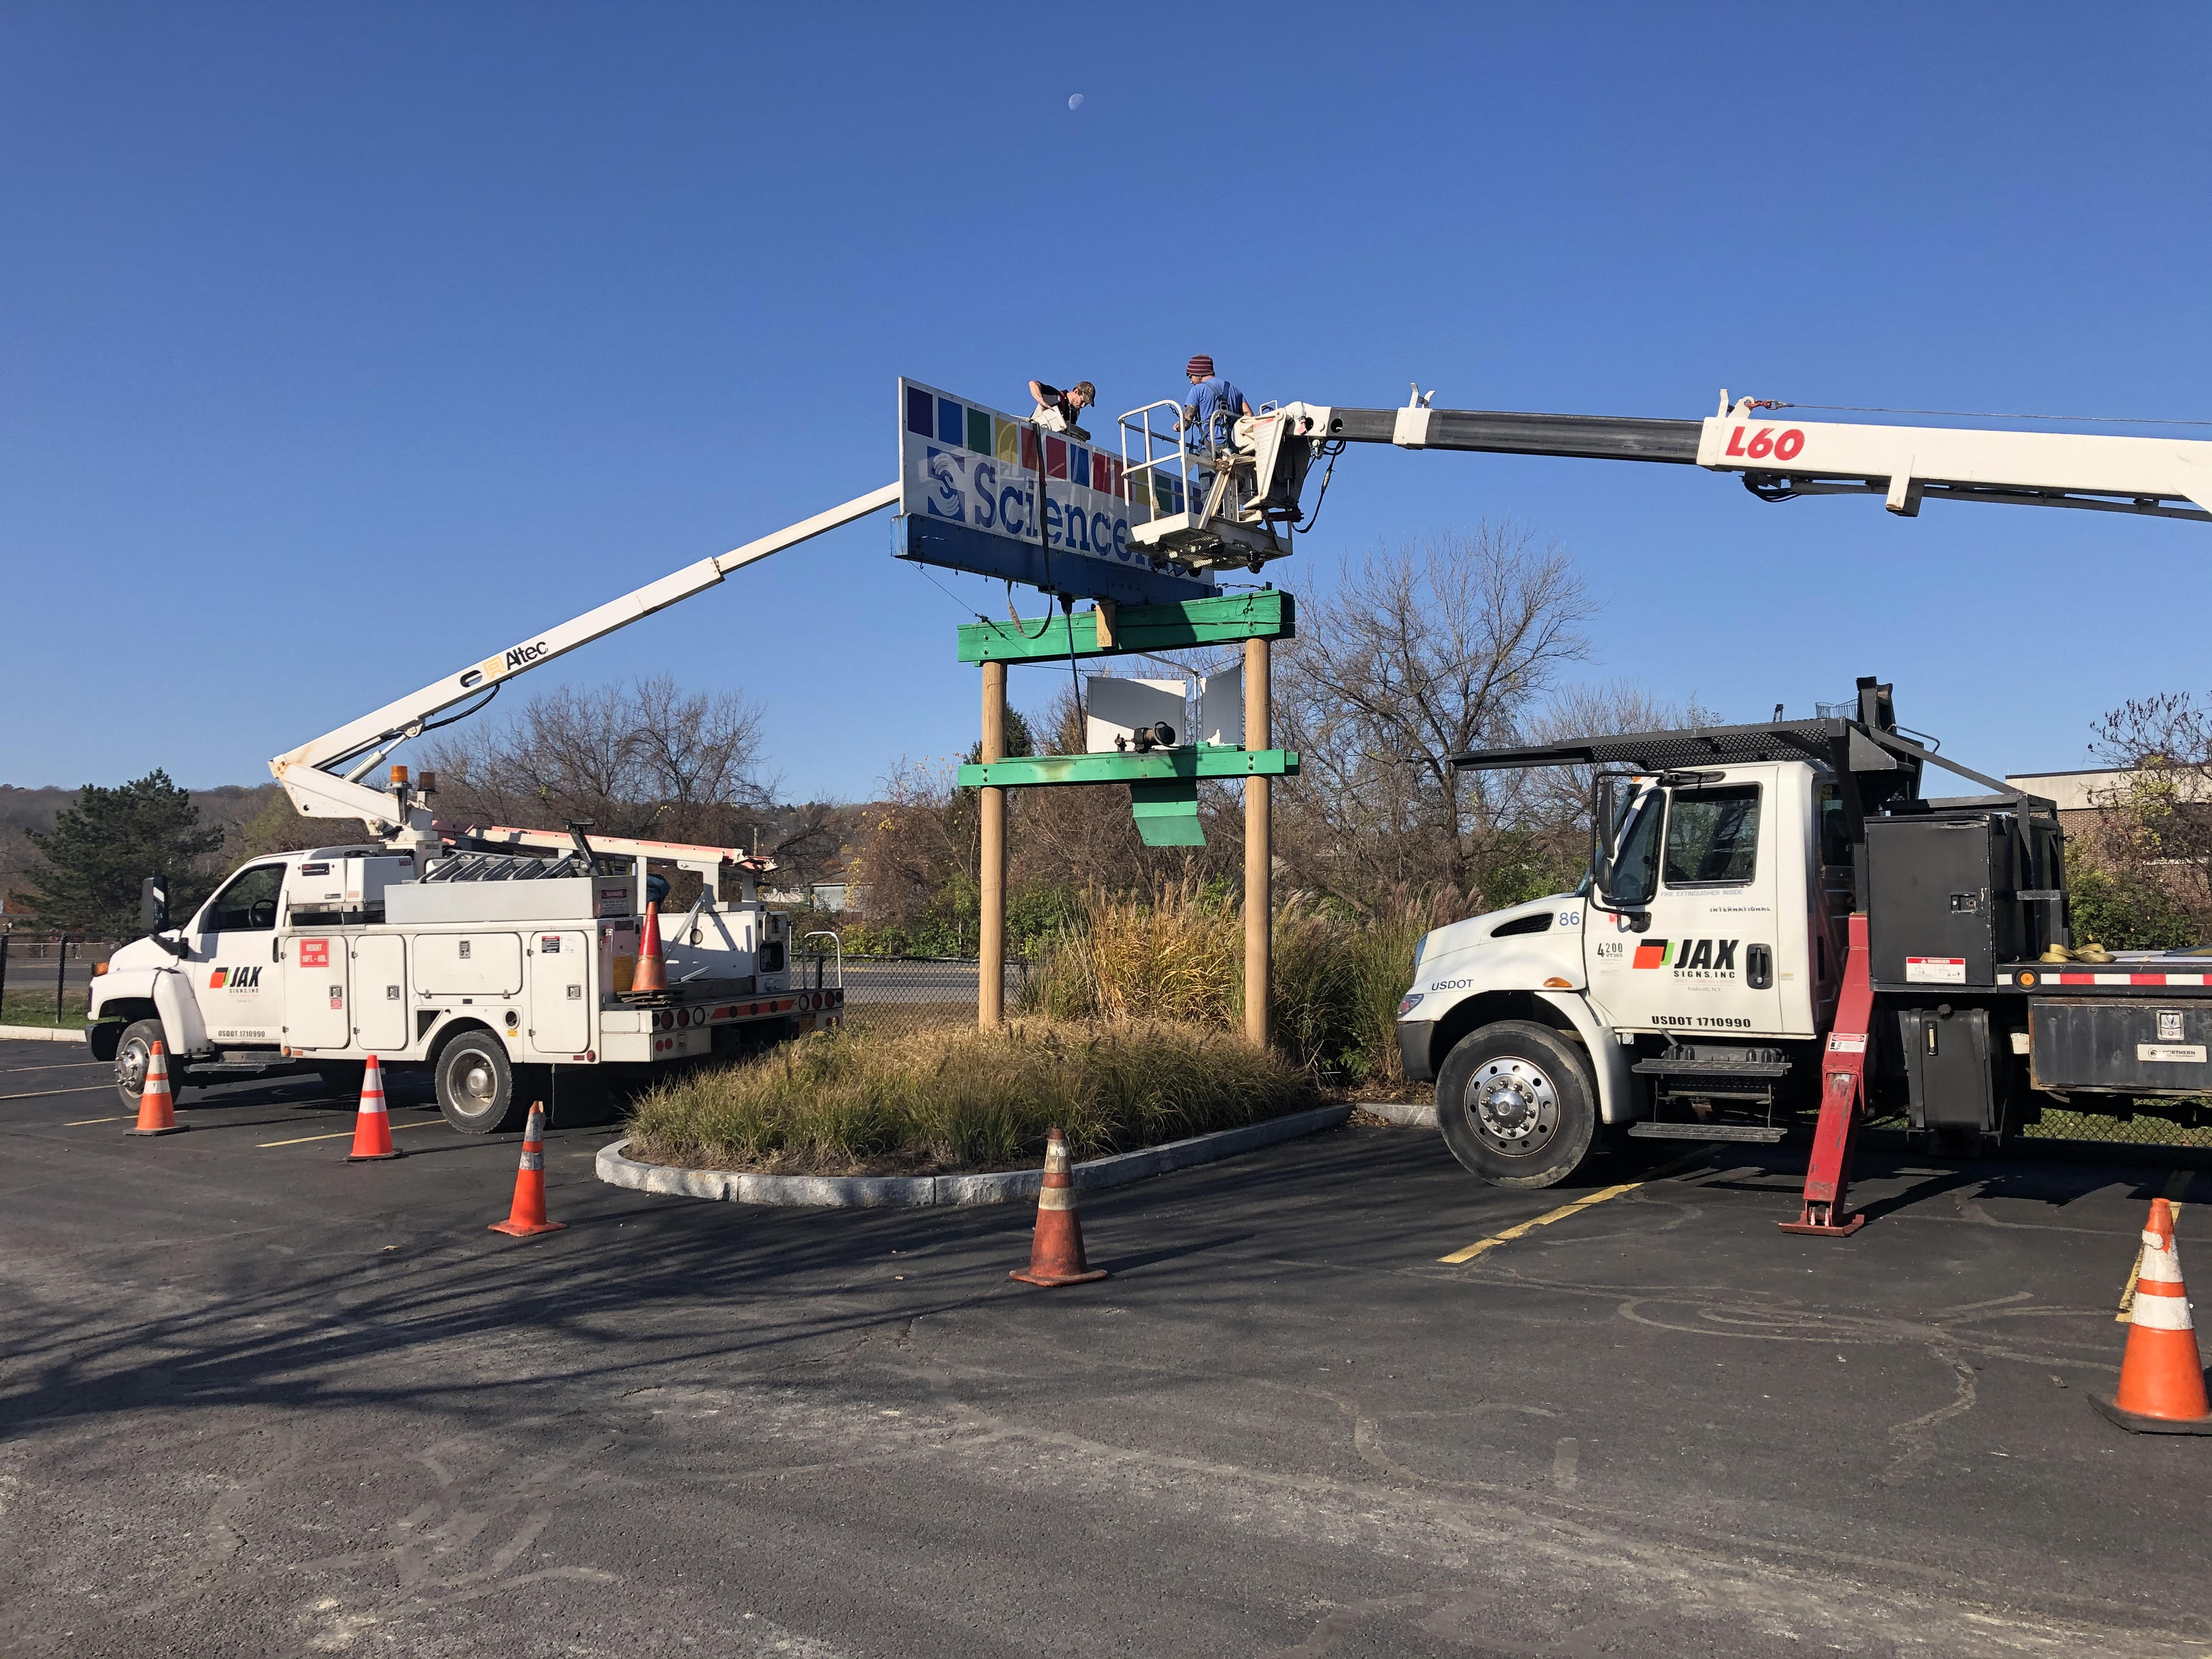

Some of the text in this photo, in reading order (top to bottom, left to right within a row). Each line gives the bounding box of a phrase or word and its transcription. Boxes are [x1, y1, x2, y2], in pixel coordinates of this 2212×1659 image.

[1725, 426, 1805, 461] L60
[506, 641, 549, 670] Altec
[1559, 911, 1580, 926] 86
[1598, 943, 1622, 957] 4200
[1674, 939, 1740, 969] JAX
[229, 966, 263, 988] JAX
[1431, 979, 1474, 991] USDOT
[1651, 1015, 1751, 1028] USDOT 1710990
